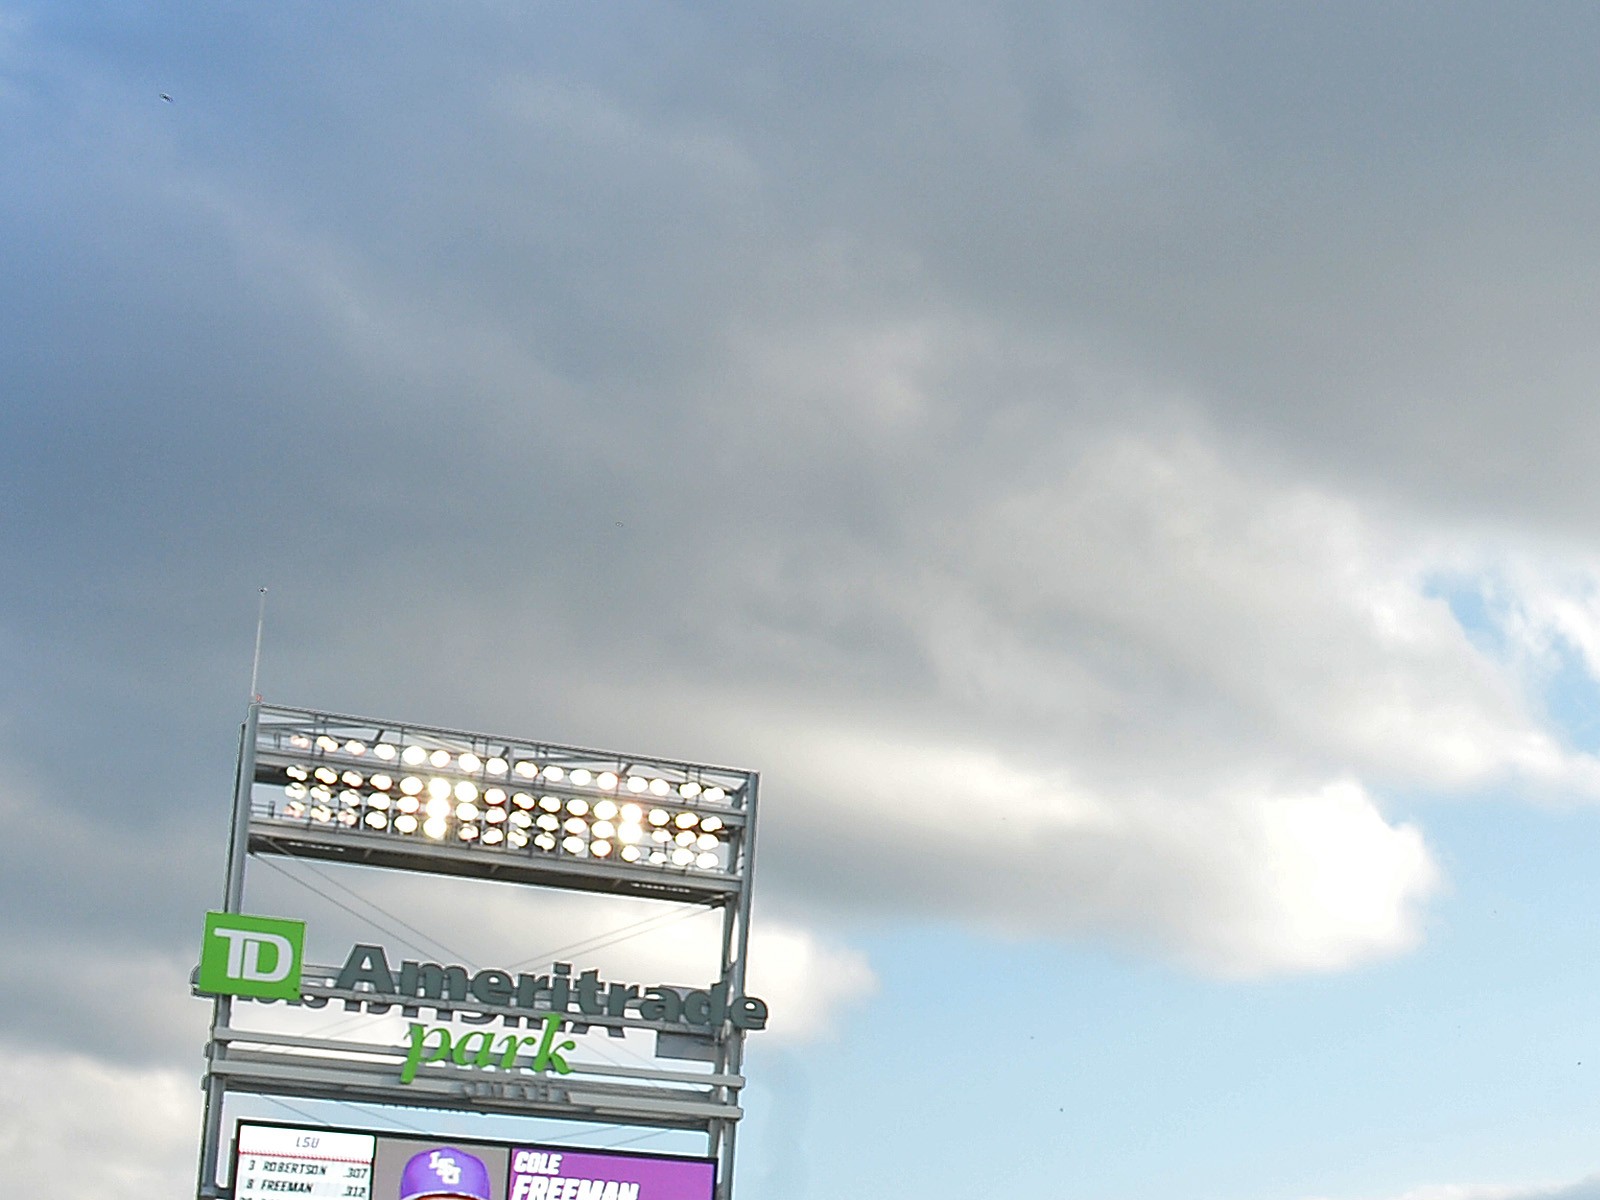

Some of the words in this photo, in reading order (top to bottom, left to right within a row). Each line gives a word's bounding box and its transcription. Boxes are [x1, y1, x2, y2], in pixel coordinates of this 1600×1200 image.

[213, 928, 294, 983] TD
[337, 944, 769, 1031] Ameritrade
[400, 1013, 577, 1084] park
[296, 1136, 320, 1149] LSU
[262, 1162, 328, 1176] ROBERTSON
[513, 1152, 562, 1175] COLE
[261, 1179, 314, 1194] FREEMAN
